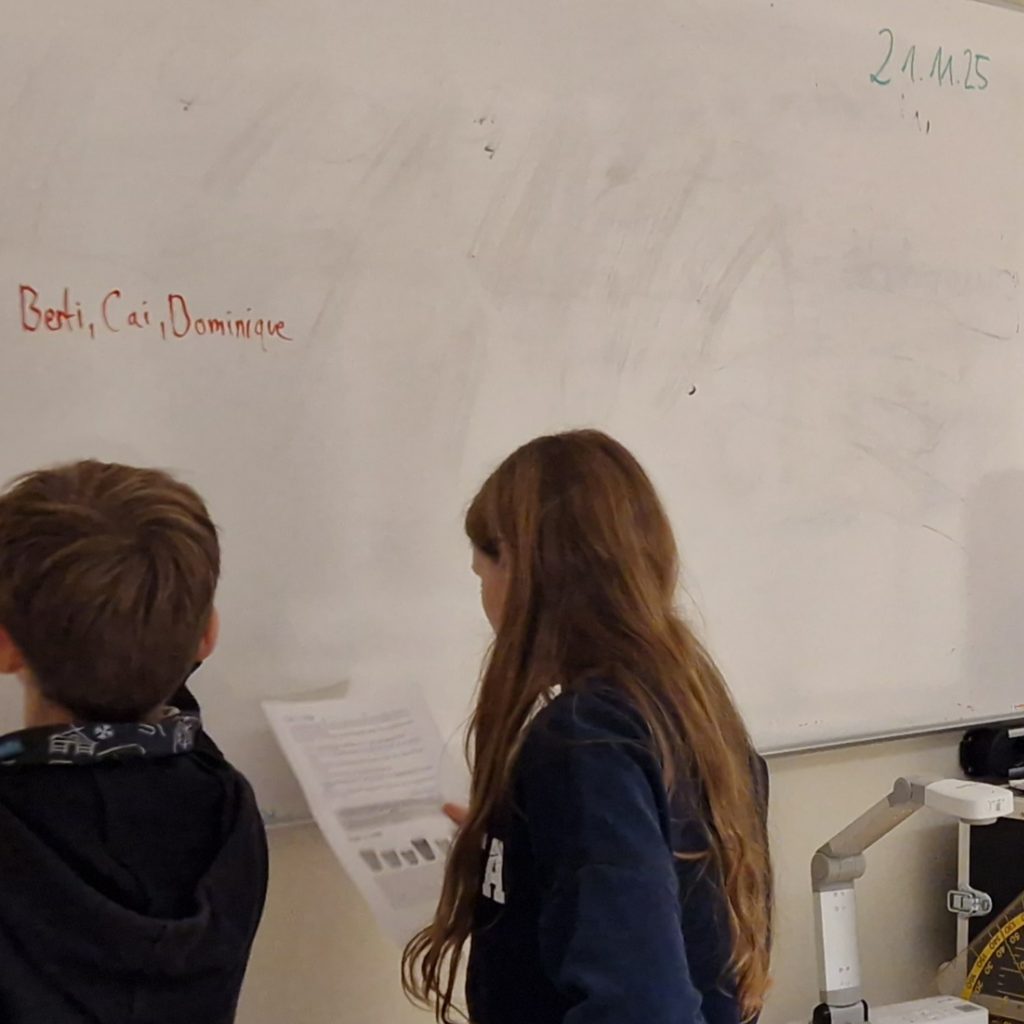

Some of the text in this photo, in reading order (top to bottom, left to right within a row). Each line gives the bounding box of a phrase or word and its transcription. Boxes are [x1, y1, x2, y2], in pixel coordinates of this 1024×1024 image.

[869, 28, 991, 90] 21.11.25
[168, 294, 293, 351] Dominique
[1009, 932, 1020, 944] 50
[995, 946, 1006, 958] 40
[983, 960, 994, 975] 30
